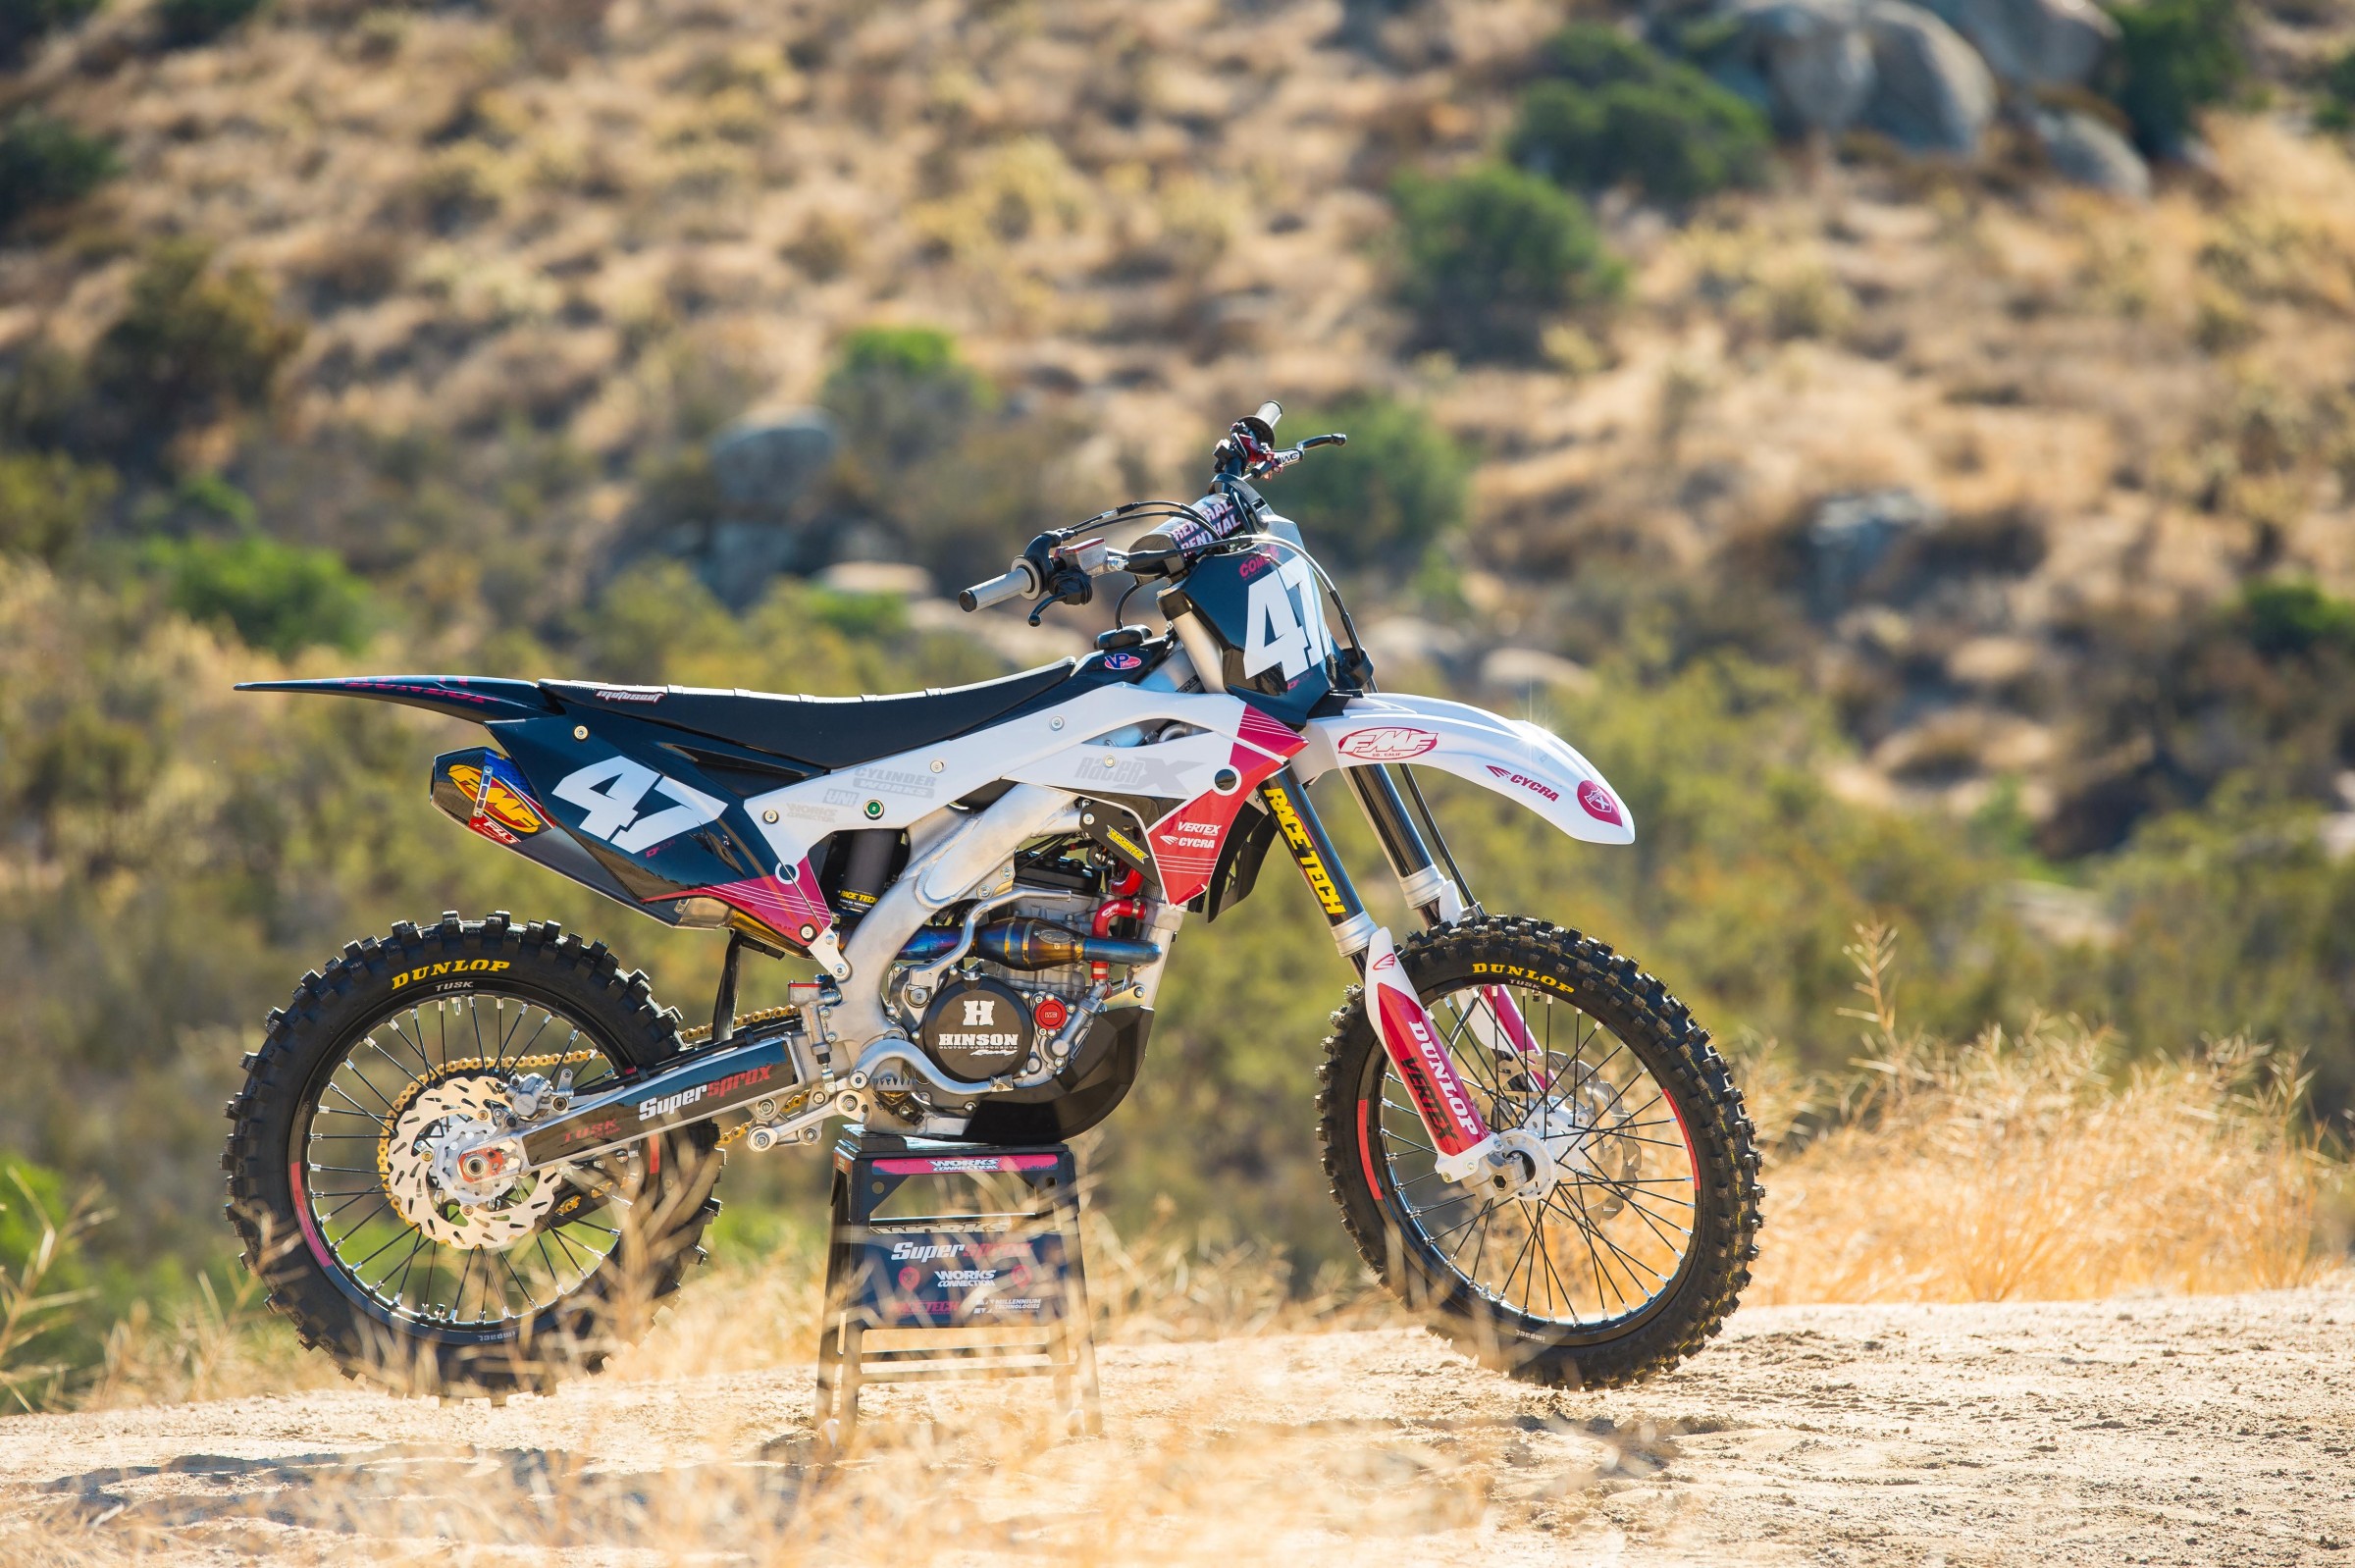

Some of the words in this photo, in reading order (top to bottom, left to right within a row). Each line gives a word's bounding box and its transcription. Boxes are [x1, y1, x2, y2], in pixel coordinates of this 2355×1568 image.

[1172, 499, 1233, 541] RENHAL
[1105, 653, 1129, 669] VP
[1338, 730, 1439, 754] FMF
[855, 767, 937, 787] CYLINDER
[1510, 774, 1559, 803] CYCRA
[550, 755, 729, 855] 47
[827, 790, 858, 807] UNI
[1178, 821, 1223, 835] VERTEX
[1178, 837, 1216, 849] CYCRA
[1264, 787, 1313, 851] RACE
[1299, 850, 1347, 915] TECH
[392, 959, 511, 990] DUNLOP
[436, 981, 474, 992] TUSK
[1472, 963, 1575, 993] DUNLOP
[963, 1000, 995, 1026] H
[939, 1033, 1019, 1046] HINSON
[1407, 1021, 1480, 1136] DUNLOP
[1401, 1057, 1458, 1140] VERTEX
[934, 1270, 997, 1281] WORKS
[938, 1280, 996, 1288] CONNECTION
